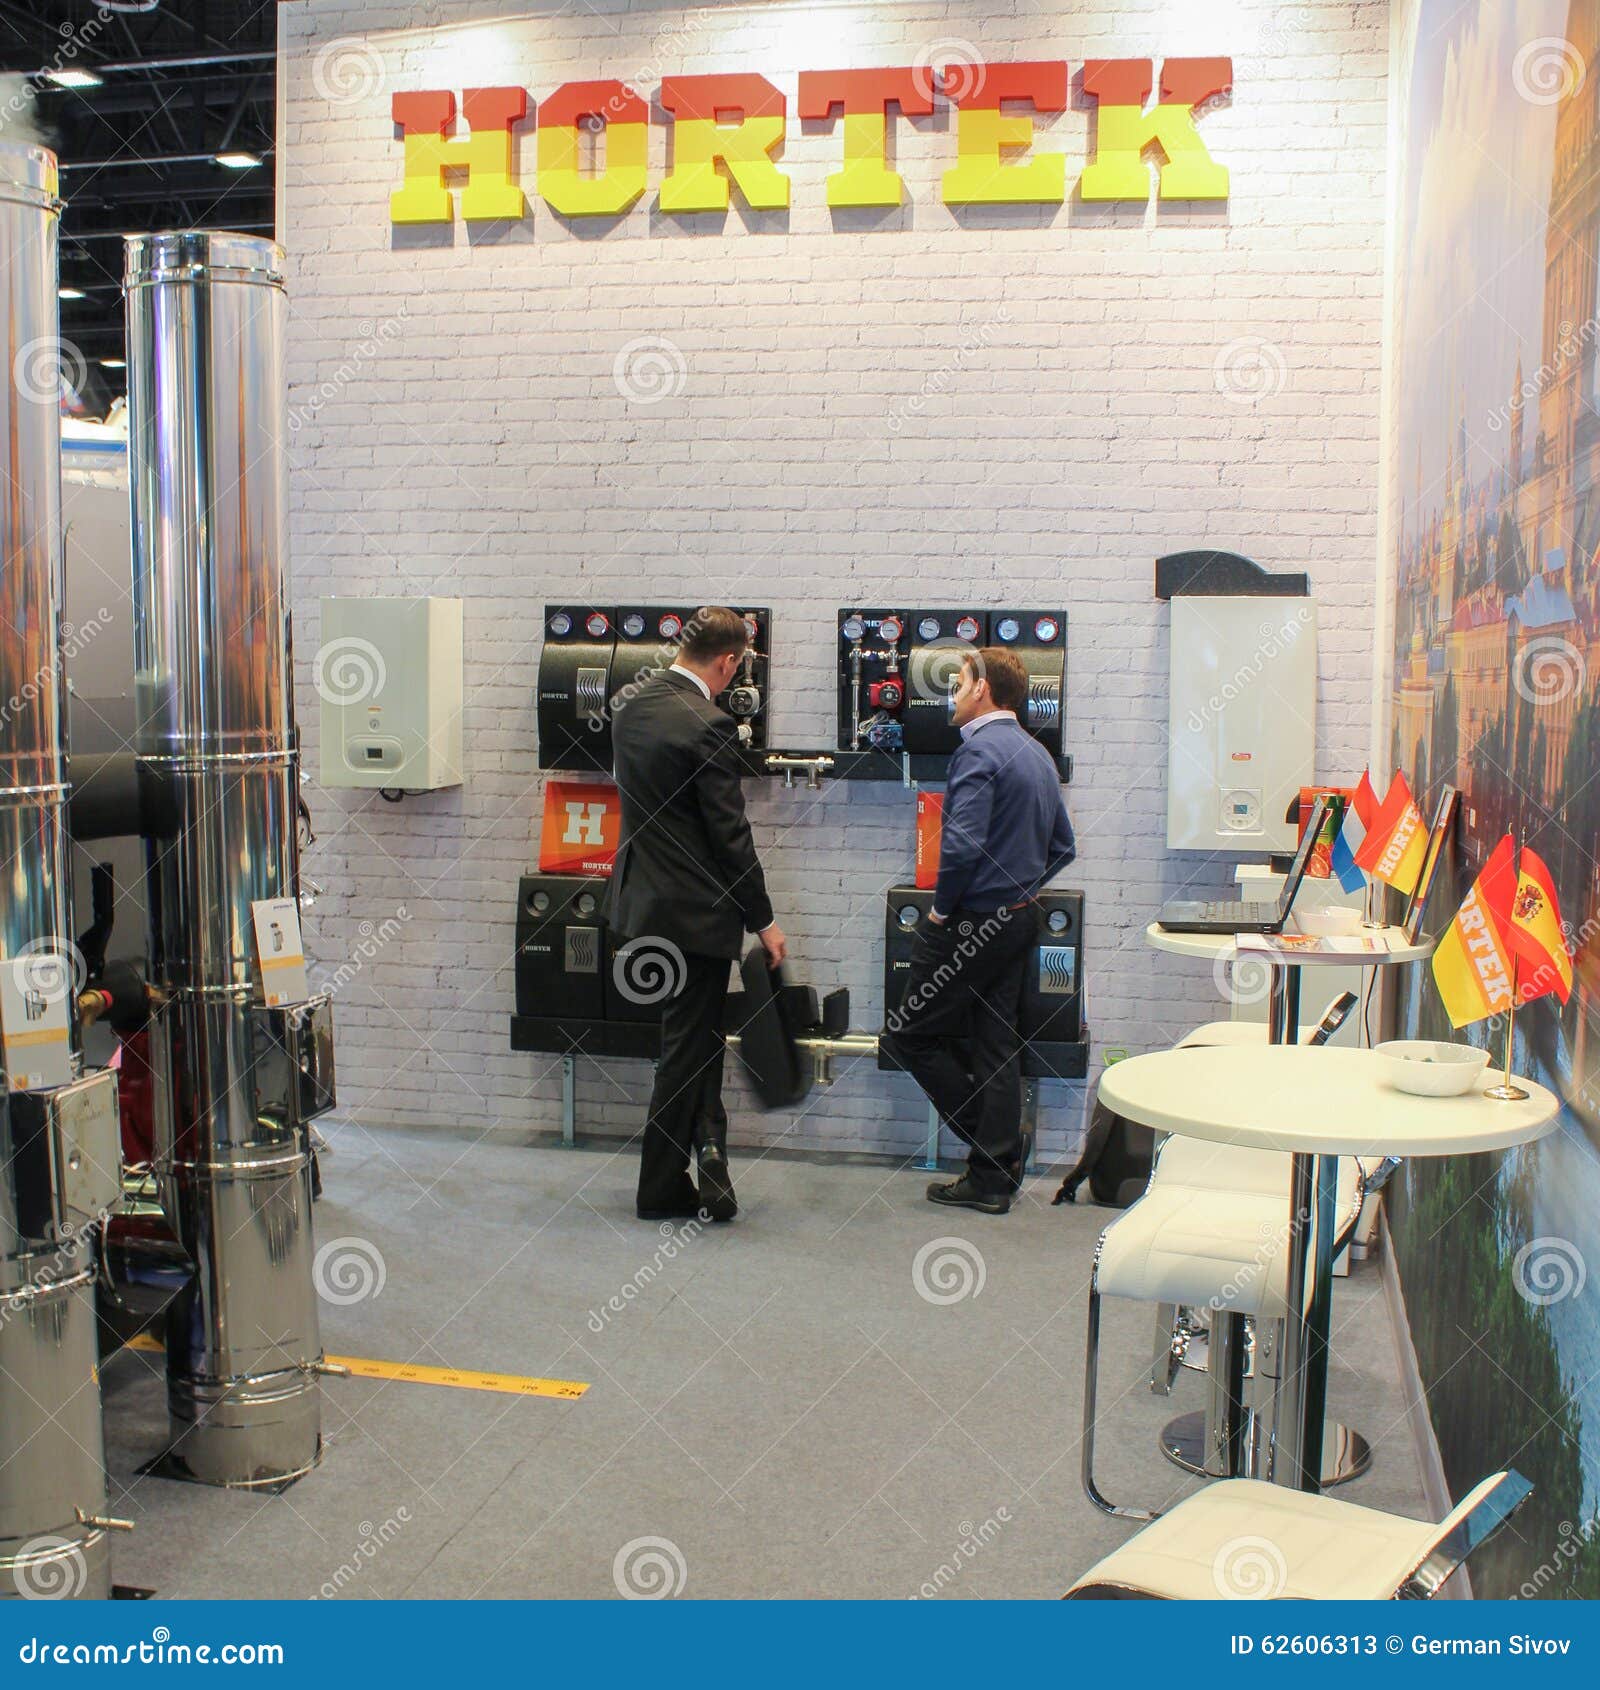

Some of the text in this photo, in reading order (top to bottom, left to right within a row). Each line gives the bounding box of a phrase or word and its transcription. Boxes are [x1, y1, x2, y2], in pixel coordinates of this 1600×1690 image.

[390, 57, 1233, 223] HORTEK
[562, 802, 606, 845] H
[1377, 800, 1421, 877] HORTE
